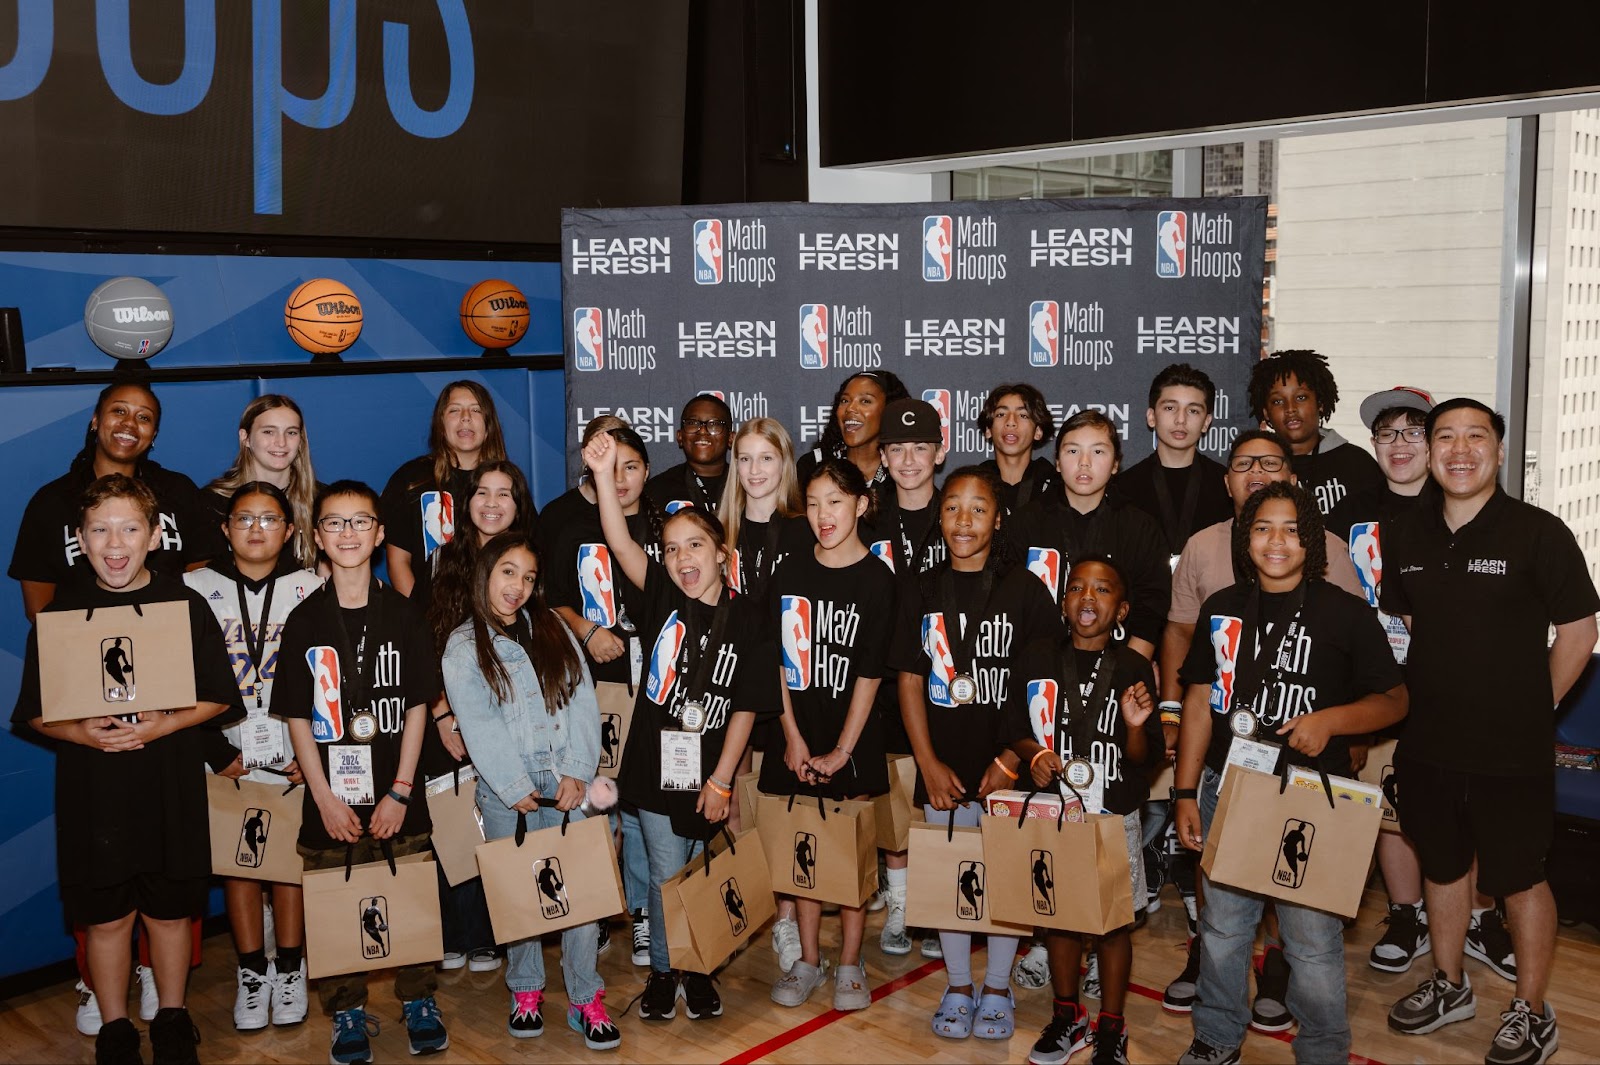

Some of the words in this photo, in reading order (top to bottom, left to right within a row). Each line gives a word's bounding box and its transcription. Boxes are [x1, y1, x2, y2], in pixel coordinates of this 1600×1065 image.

[728, 219, 766, 250] Math
[957, 216, 997, 248] Math
[1192, 212, 1232, 244] Math
[572, 237, 670, 256] LEARN
[799, 233, 898, 251] LEARN
[1031, 227, 1132, 248] LEARN
[572, 256, 670, 275] FRESH
[799, 252, 898, 271] FRESH
[1030, 248, 1132, 268] FRESH
[1191, 246, 1242, 283] Hoops
[698, 270, 712, 280] NBA
[728, 252, 776, 288] Hoops
[926, 266, 941, 278] NBA
[957, 249, 1007, 286] Hoops
[1160, 262, 1175, 274] NBA
[112, 306, 169, 324] Wilson
[316, 300, 361, 316] Wilson
[607, 308, 646, 339] Math
[833, 305, 872, 336] Math
[1064, 302, 1104, 334] Math
[1138, 316, 1240, 334] LEARN
[678, 320, 776, 340] LEARN
[904, 318, 1005, 338] LEARN
[678, 340, 776, 358] FRESH
[904, 338, 1005, 356] FRESH
[1064, 334, 1113, 371] Hoops
[1138, 336, 1240, 354] FRESH
[580, 356, 594, 367] NBA
[608, 340, 656, 376] Hoops
[804, 354, 818, 364] NBA
[833, 337, 882, 372] Hoops
[1033, 352, 1048, 362] NBA
[902, 411, 916, 426] C
[1315, 478, 1347, 515] ath
[1467, 565, 1506, 576] FRESH
[1468, 559, 1506, 568] LEARN
[587, 608, 602, 623] NBA
[342, 755, 360, 766] 2024
[240, 852, 252, 863] NBA
[796, 874, 806, 884] NBA
[1278, 869, 1292, 883] NBA
[546, 904, 560, 916] NBA
[960, 906, 973, 917] NBA
[1036, 900, 1048, 911] NBA
[366, 945, 380, 956] NBA
